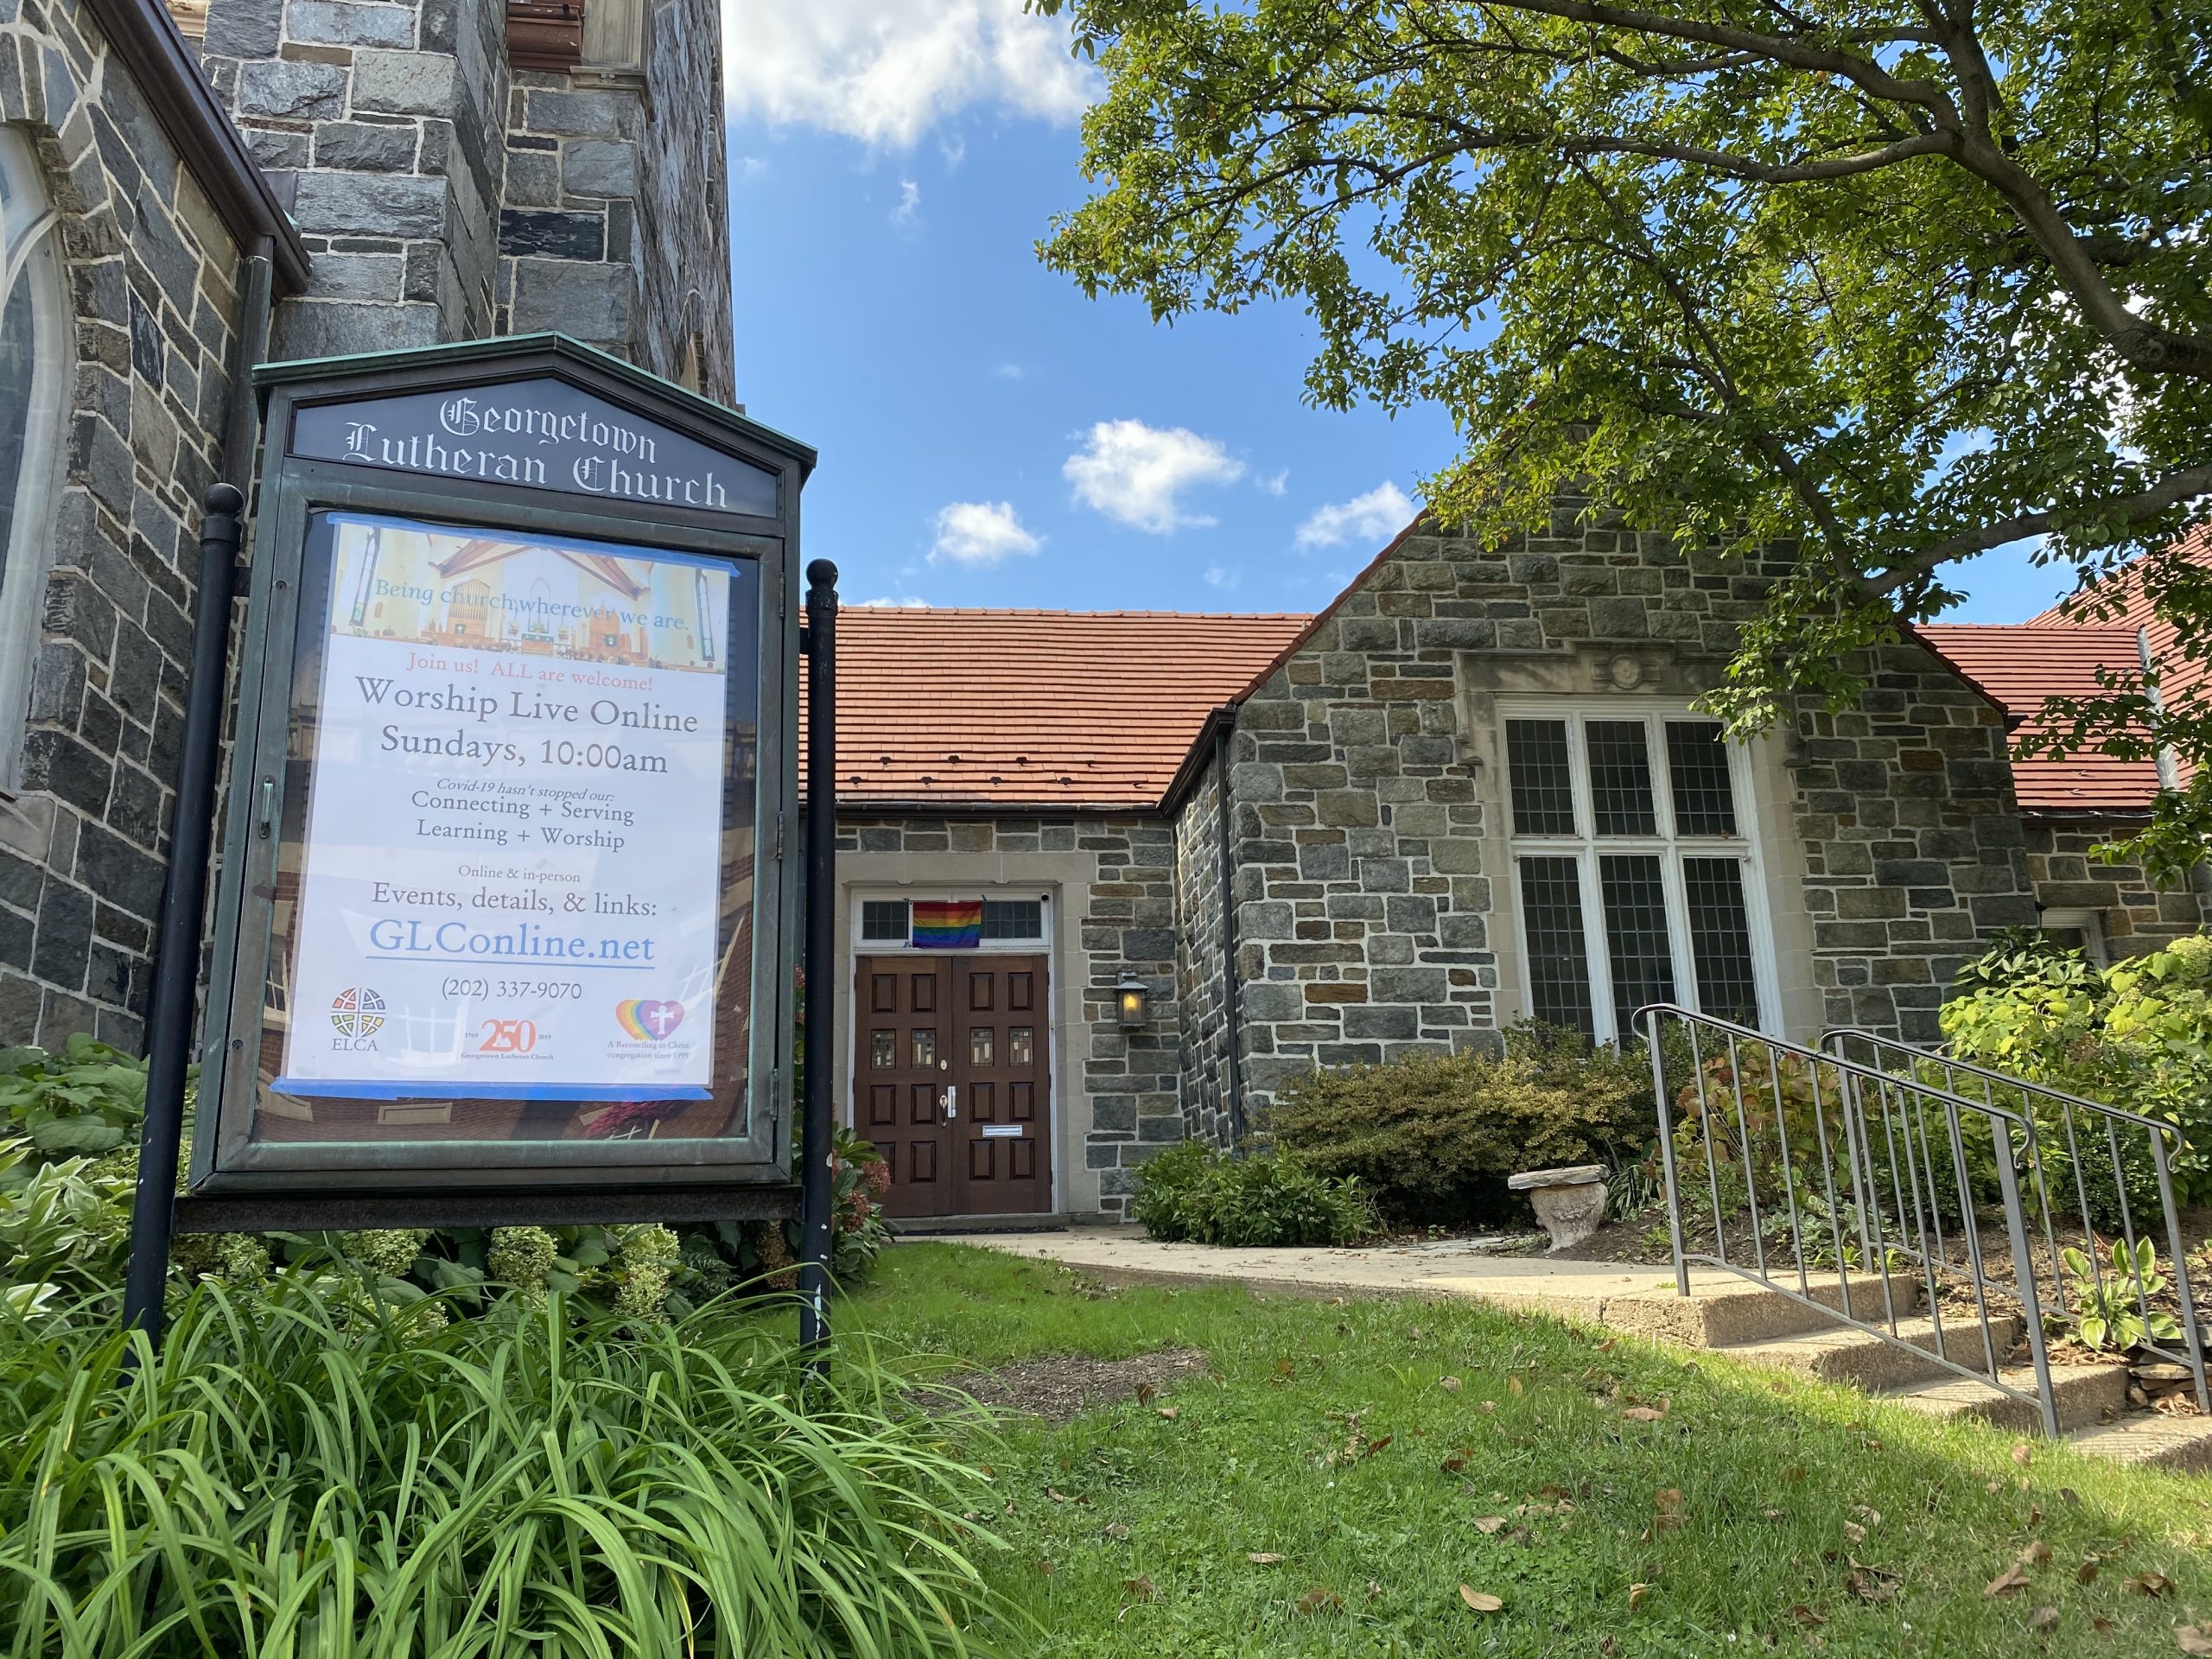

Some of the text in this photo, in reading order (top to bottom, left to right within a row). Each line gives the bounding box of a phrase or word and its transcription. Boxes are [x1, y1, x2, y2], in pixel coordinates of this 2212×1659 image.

[440, 396, 657, 465] Georgetown
[343, 422, 728, 510] Lutheran Church
[375, 579, 433, 606] Being
[518, 596, 619, 621] wherever
[620, 613, 648, 627] we
[654, 614, 690, 631] are.
[407, 652, 655, 691] Join us! ALL are welcome!
[354, 675, 698, 733] Worship Live Online
[380, 724, 669, 774] Sundays, 10:00am
[410, 790, 635, 827] Connecting + Serving
[436, 778, 614, 803] Covid-19 hasn't stopped our:
[416, 818, 626, 852] Learning + Worship
[458, 864, 581, 885] Online & in-person
[372, 881, 658, 918] Events, details, & links:
[369, 918, 655, 961] GLConline.net
[442, 976, 582, 1001] (202) 337-9070
[332, 1037, 378, 1052] ELCA
[479, 1019, 537, 1053] 250
[616, 1041, 658, 1050] Reconciling
[607, 1052, 652, 1060] congregation
